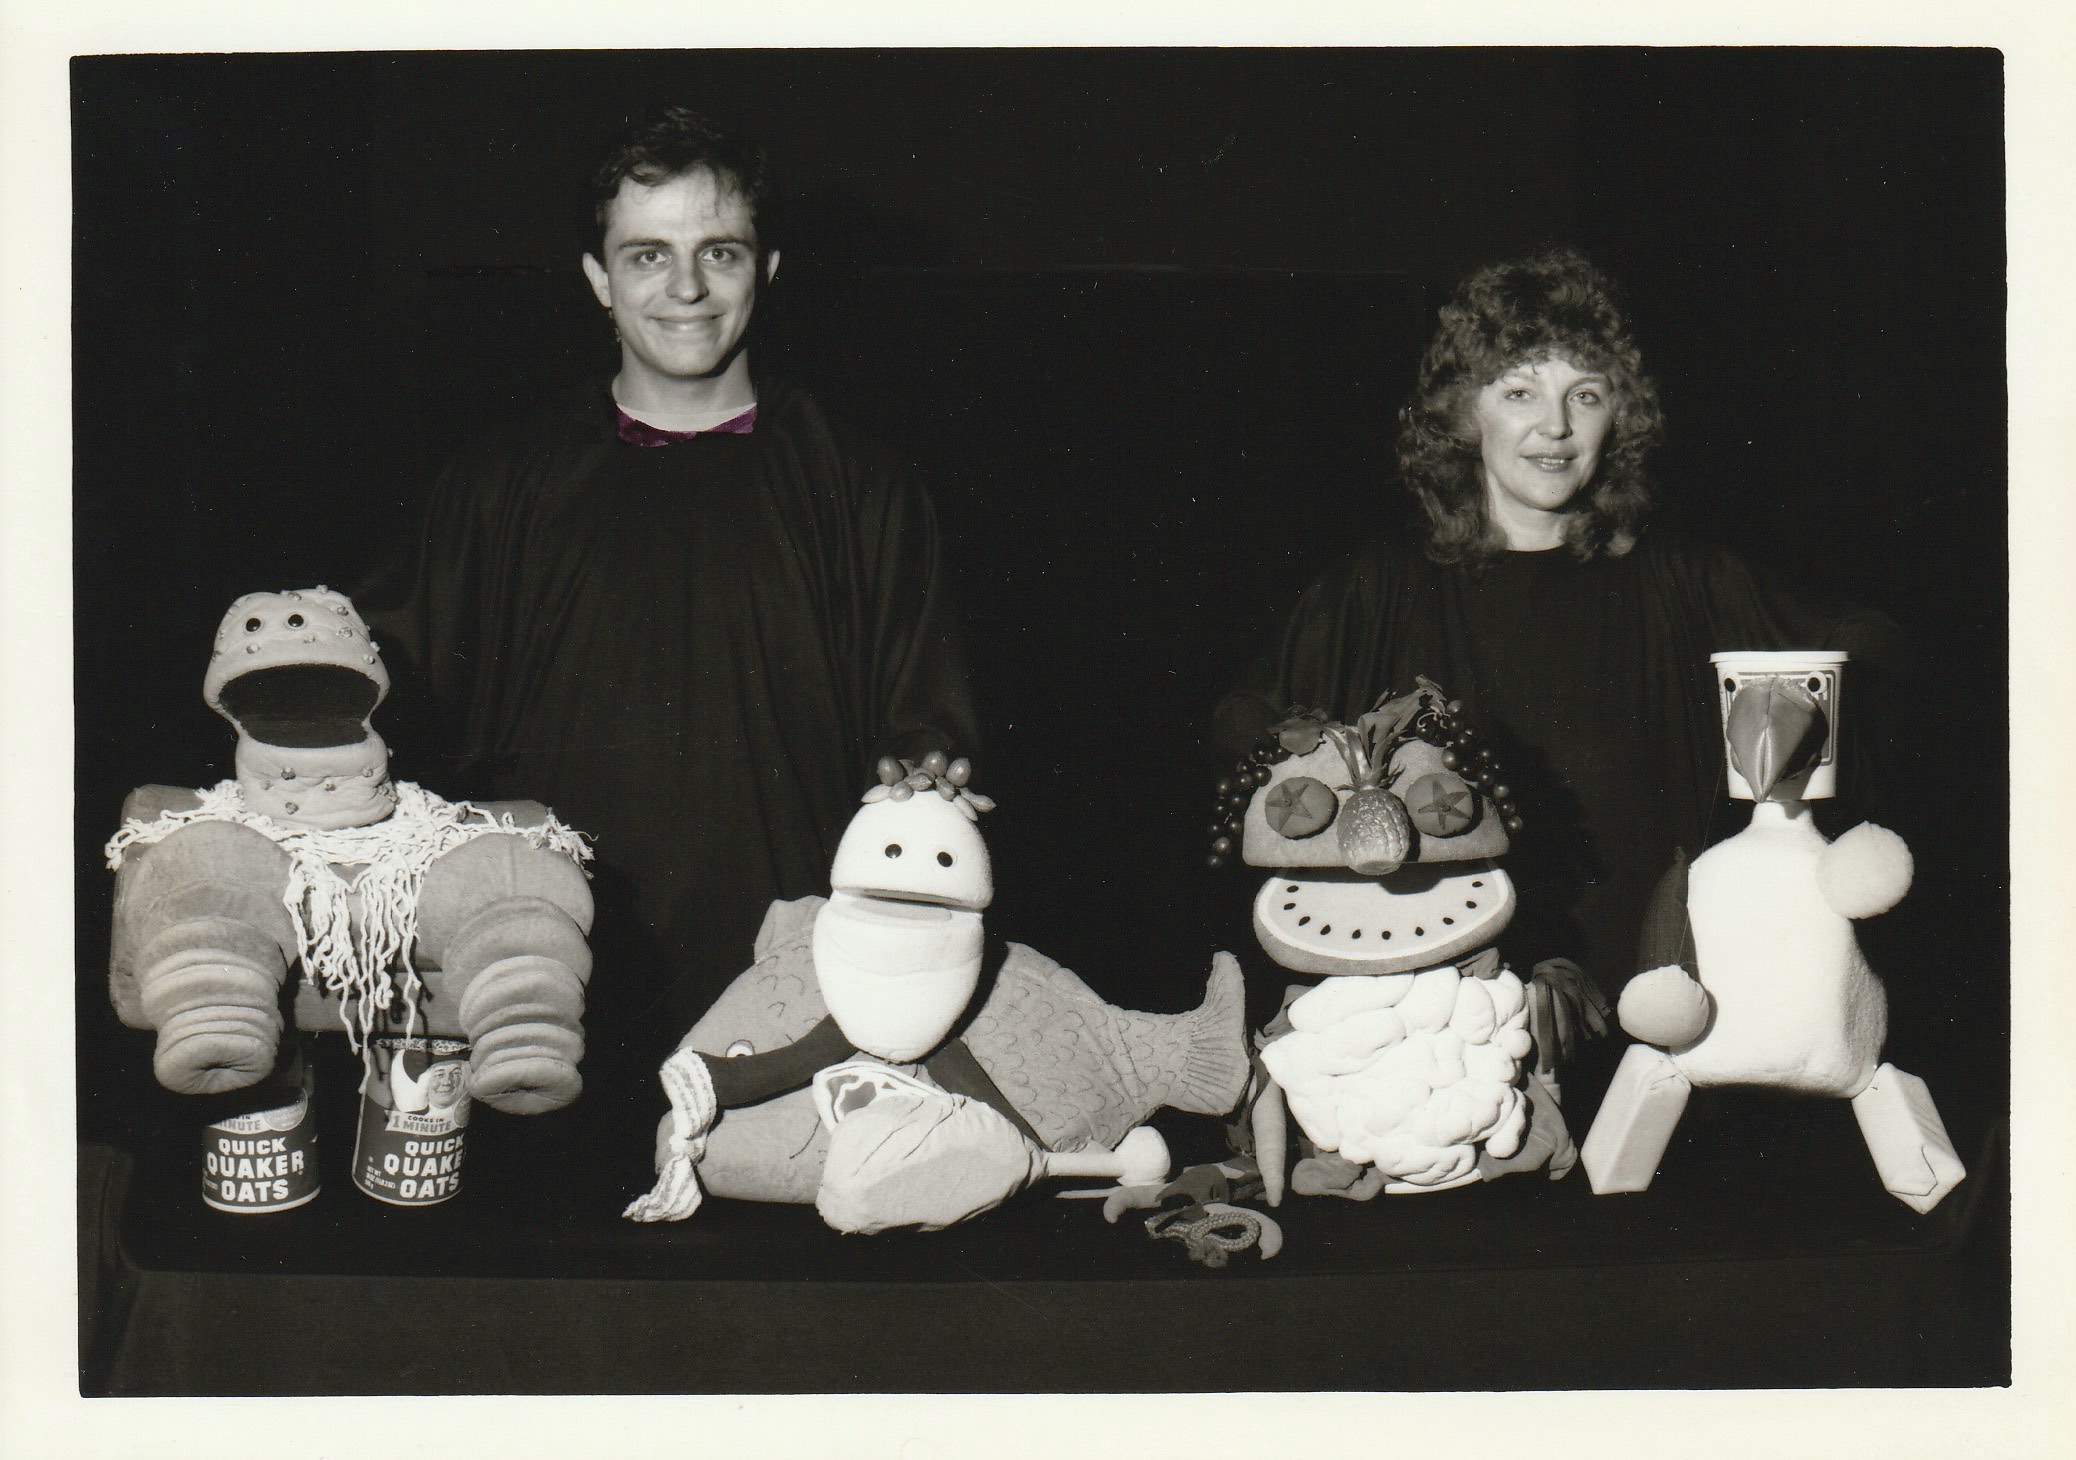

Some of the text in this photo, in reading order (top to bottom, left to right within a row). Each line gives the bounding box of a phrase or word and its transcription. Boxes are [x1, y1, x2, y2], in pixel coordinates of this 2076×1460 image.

[392, 1115, 452, 1133] 1 MINUTE
[407, 1115, 433, 1123] COOKS
[218, 1137, 287, 1156] QUICK
[404, 1132, 465, 1157] QUICK
[206, 1150, 305, 1179] QUAKER
[384, 1149, 464, 1177] QUAKE
[221, 1178, 289, 1203] OATS
[399, 1171, 460, 1199] OATS
